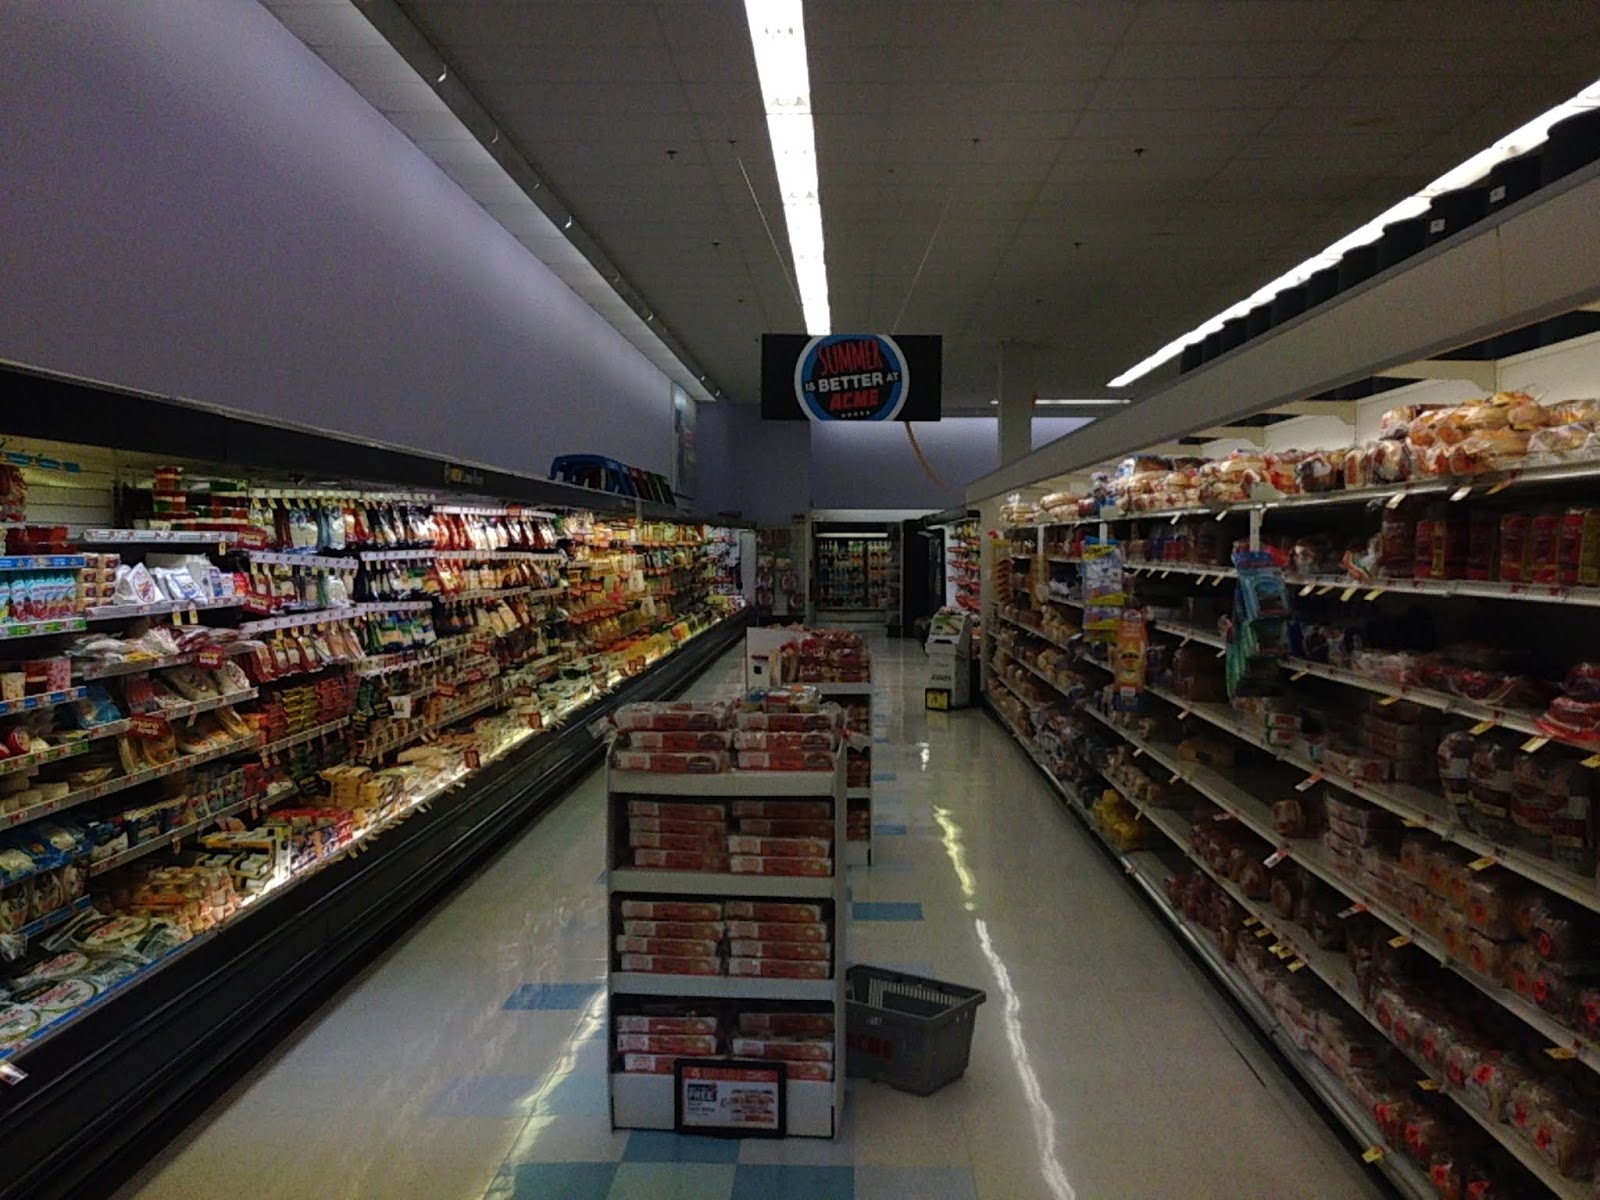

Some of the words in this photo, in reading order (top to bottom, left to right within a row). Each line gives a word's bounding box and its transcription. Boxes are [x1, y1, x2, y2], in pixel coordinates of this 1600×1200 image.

[818, 340, 884, 377] SUMMER
[805, 382, 816, 392] IS
[818, 371, 884, 393] BETTER
[886, 371, 899, 382] AT
[829, 388, 880, 411] ACME
